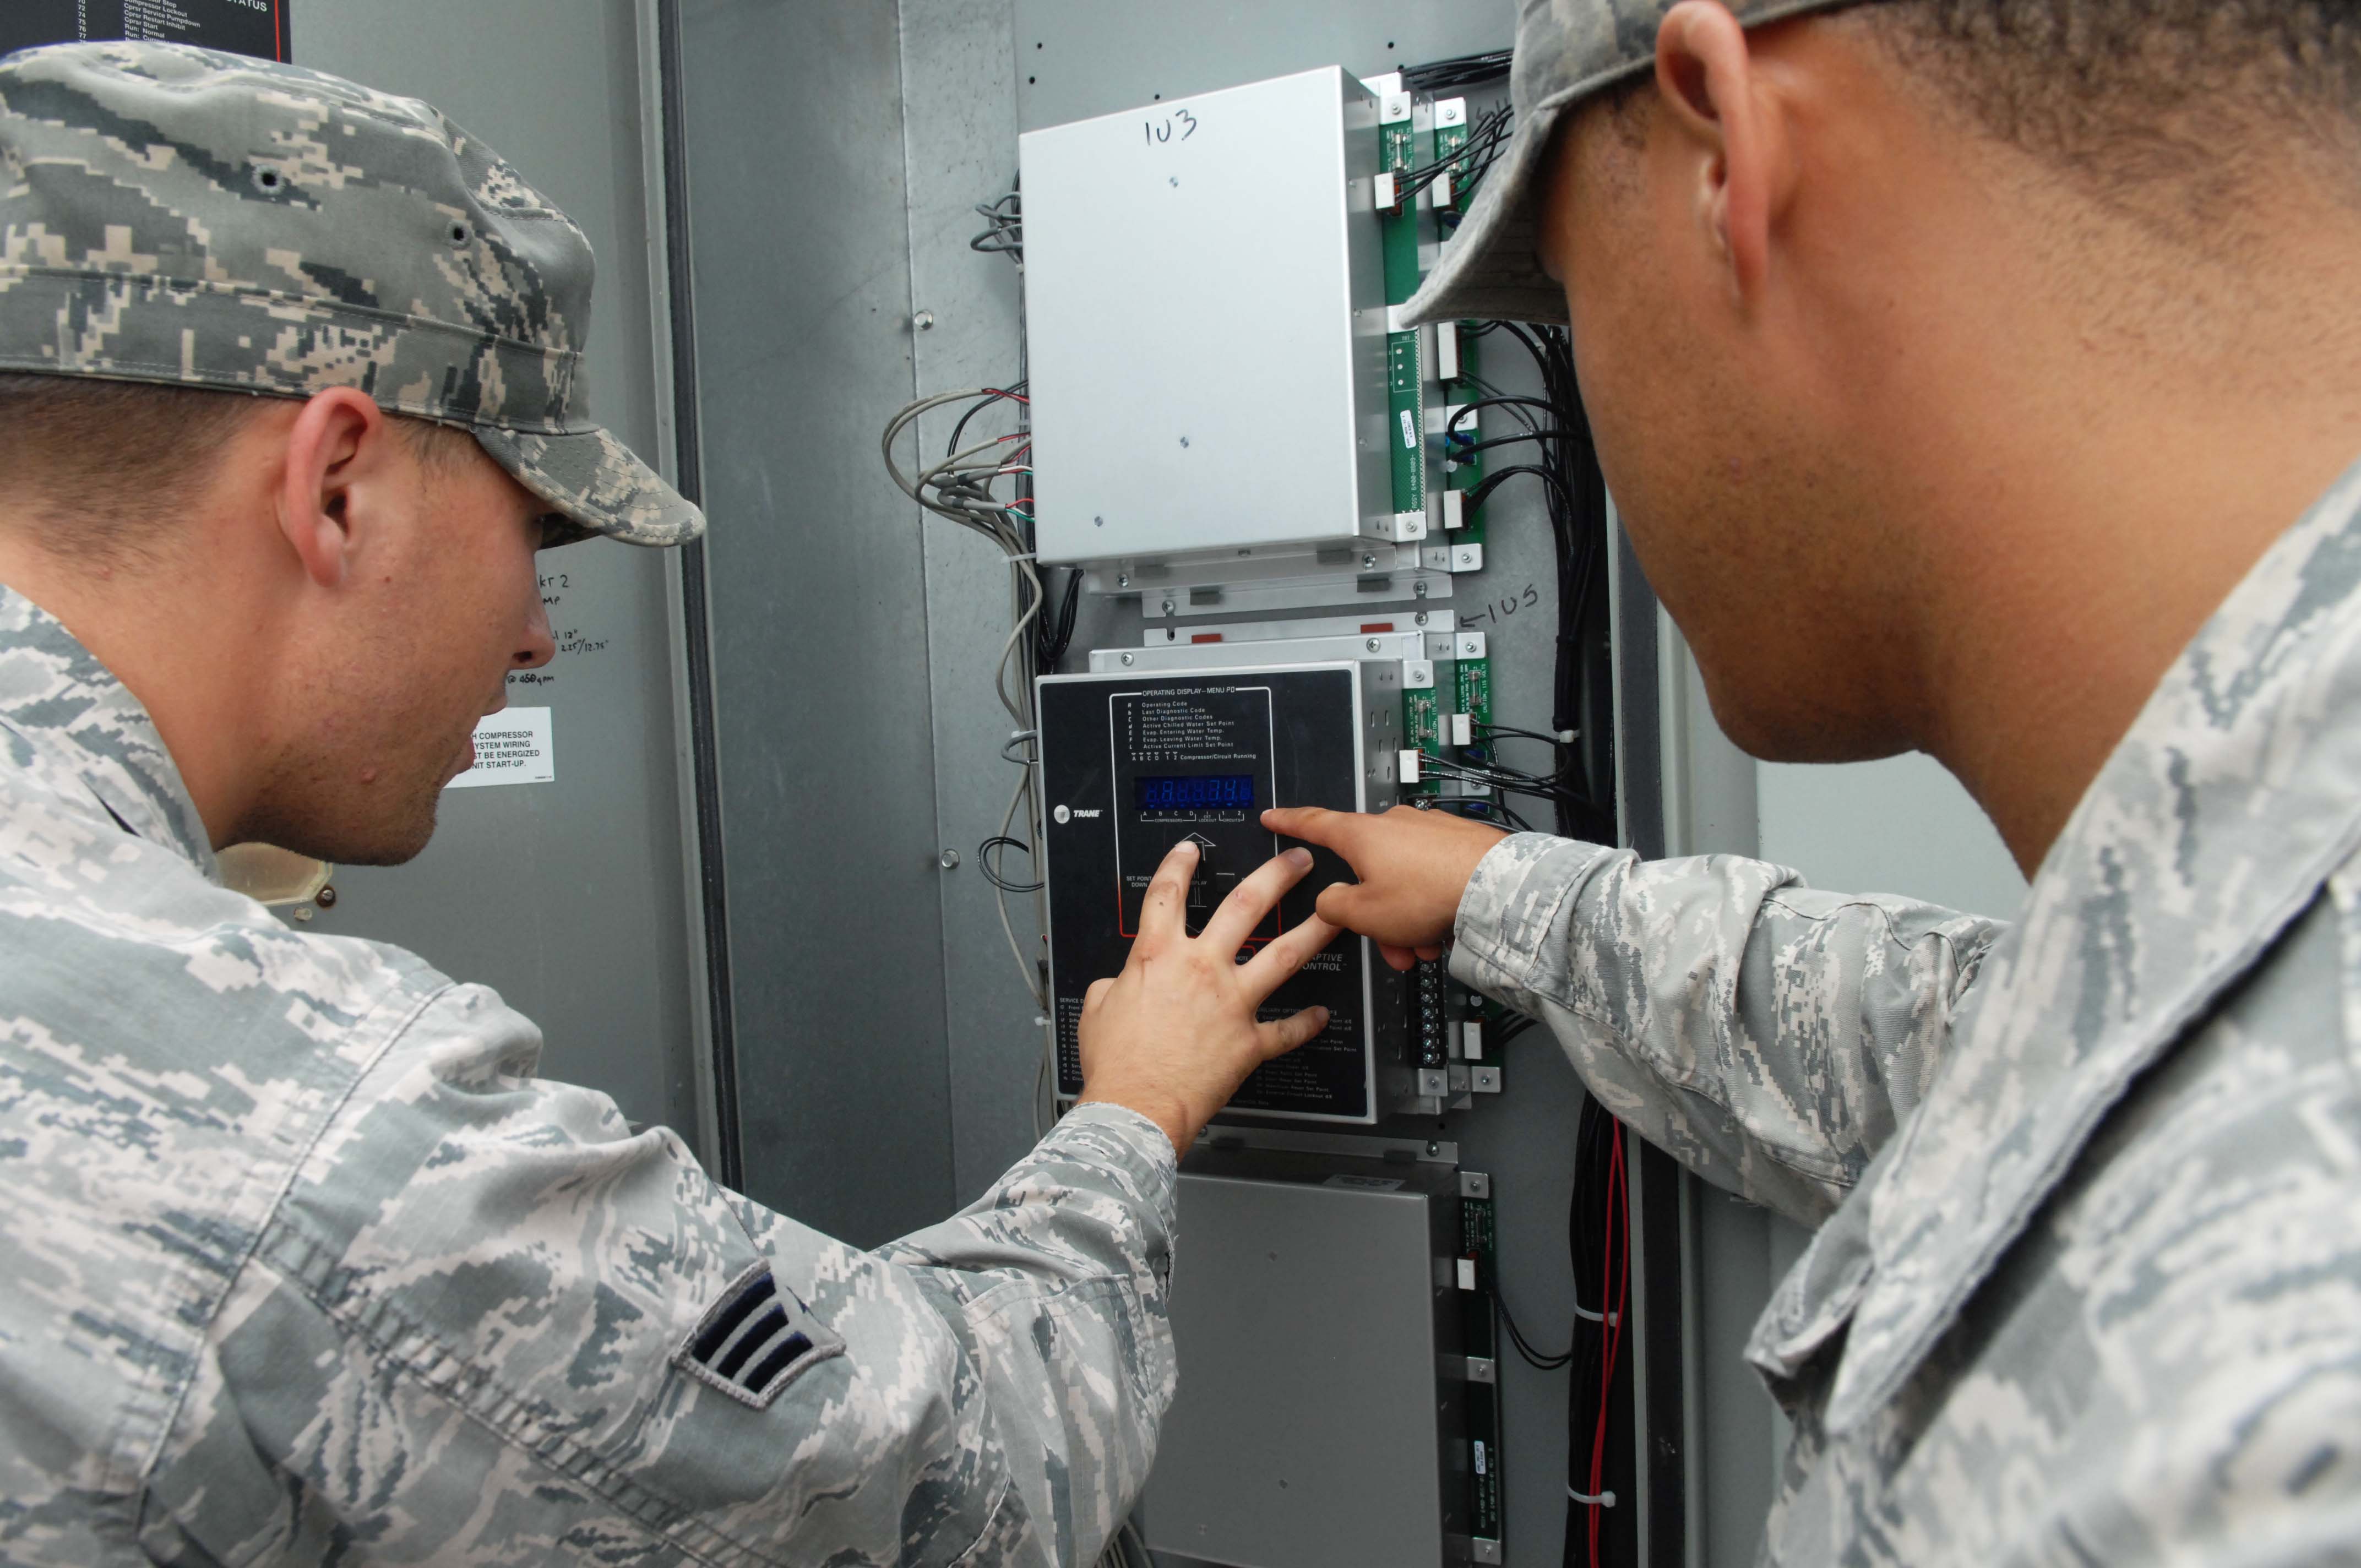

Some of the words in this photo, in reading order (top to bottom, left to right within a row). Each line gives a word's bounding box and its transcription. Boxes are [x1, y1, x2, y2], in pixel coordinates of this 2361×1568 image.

[226, 0, 267, 12] ATUS
[162, 7, 188, 18] Lockout
[143, 8, 166, 19] Service
[167, 14, 201, 28] Pumpdown
[143, 14, 166, 25] Restart
[166, 21, 186, 31] Inhibit
[143, 21, 159, 30] Start
[124, 24, 140, 32] Run:
[143, 28, 165, 39] Normal
[124, 30, 140, 39] Run:
[560, 574, 569, 588] 2
[479, 731, 533, 740] COMPRESSOR
[503, 741, 531, 749] WIRING
[497, 750, 540, 759] ENERGIZED
[486, 760, 527, 769] START-UP.
[1073, 809, 1100, 818] TRANE
